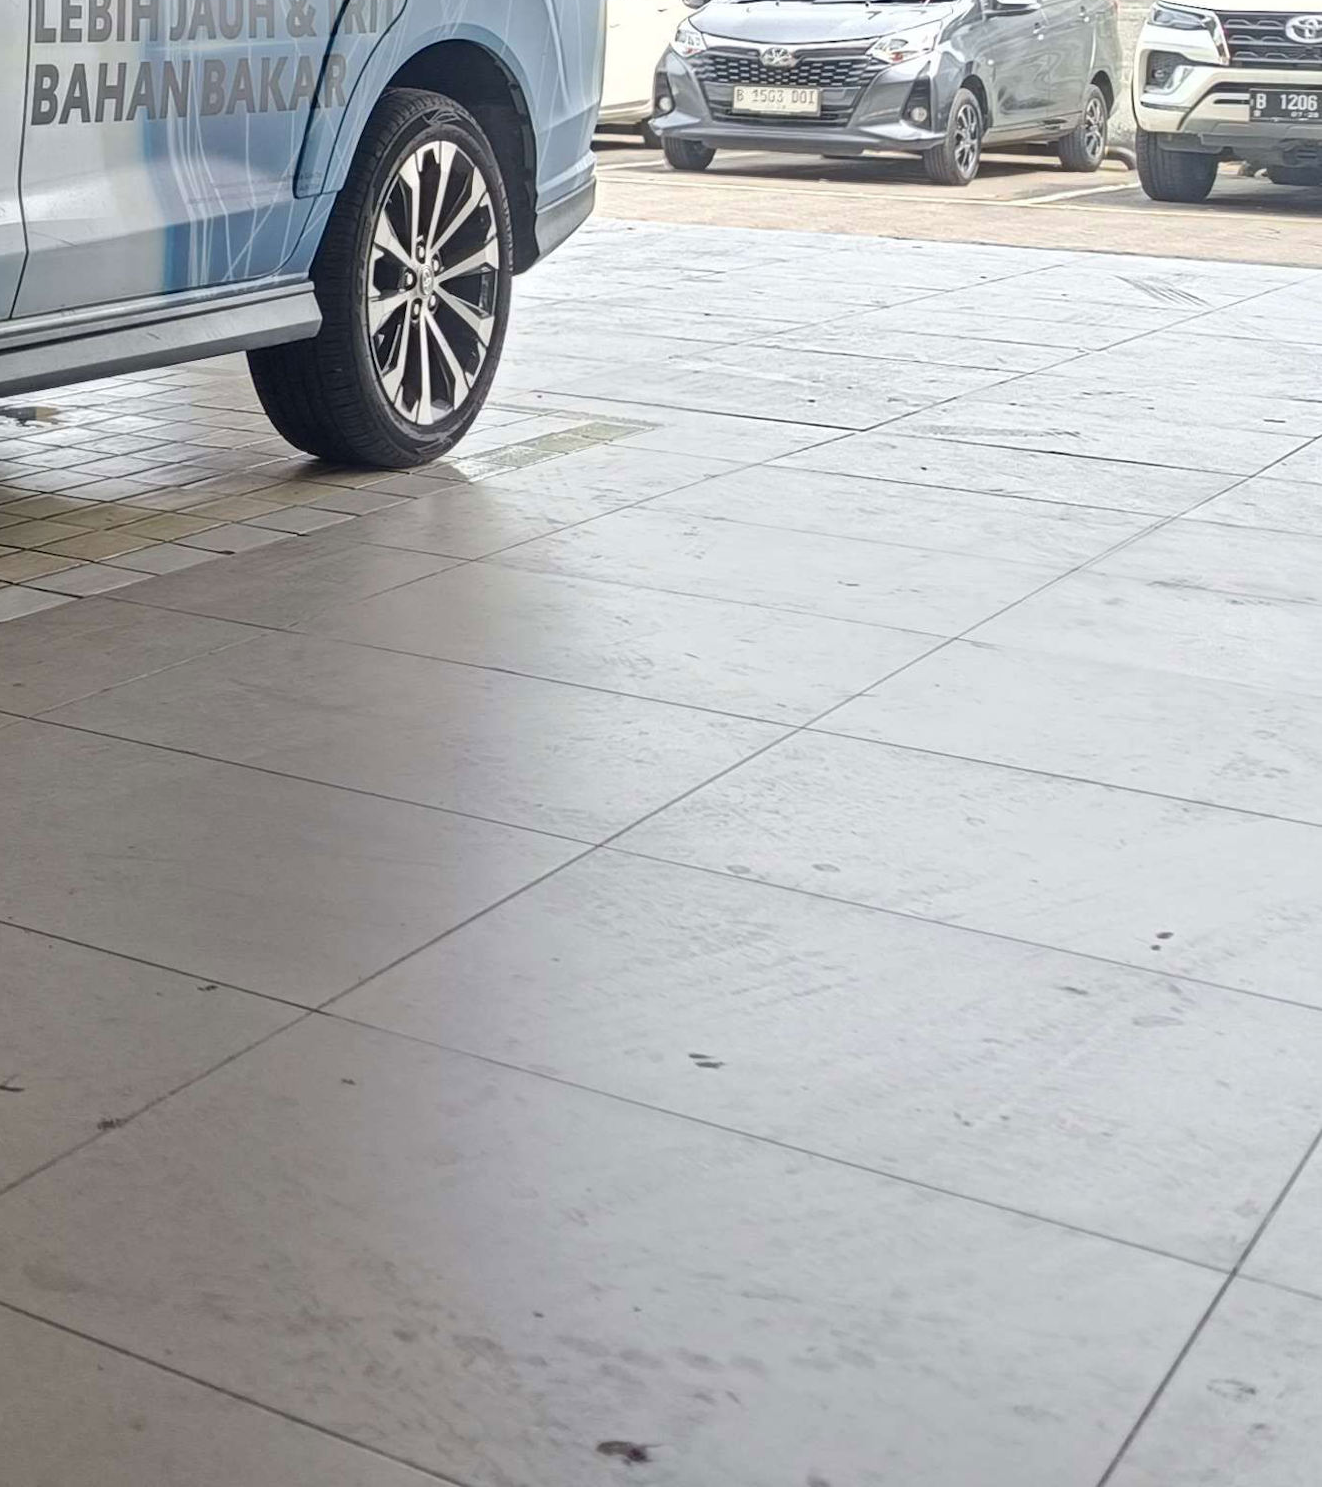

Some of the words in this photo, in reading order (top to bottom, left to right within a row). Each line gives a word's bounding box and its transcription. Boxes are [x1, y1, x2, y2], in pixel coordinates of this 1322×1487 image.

[31, 59, 192, 127] BAHAN
[202, 54, 348, 118] BAKAR
[1256, 93, 1267, 109] B
[1280, 94, 1318, 111] 1206
